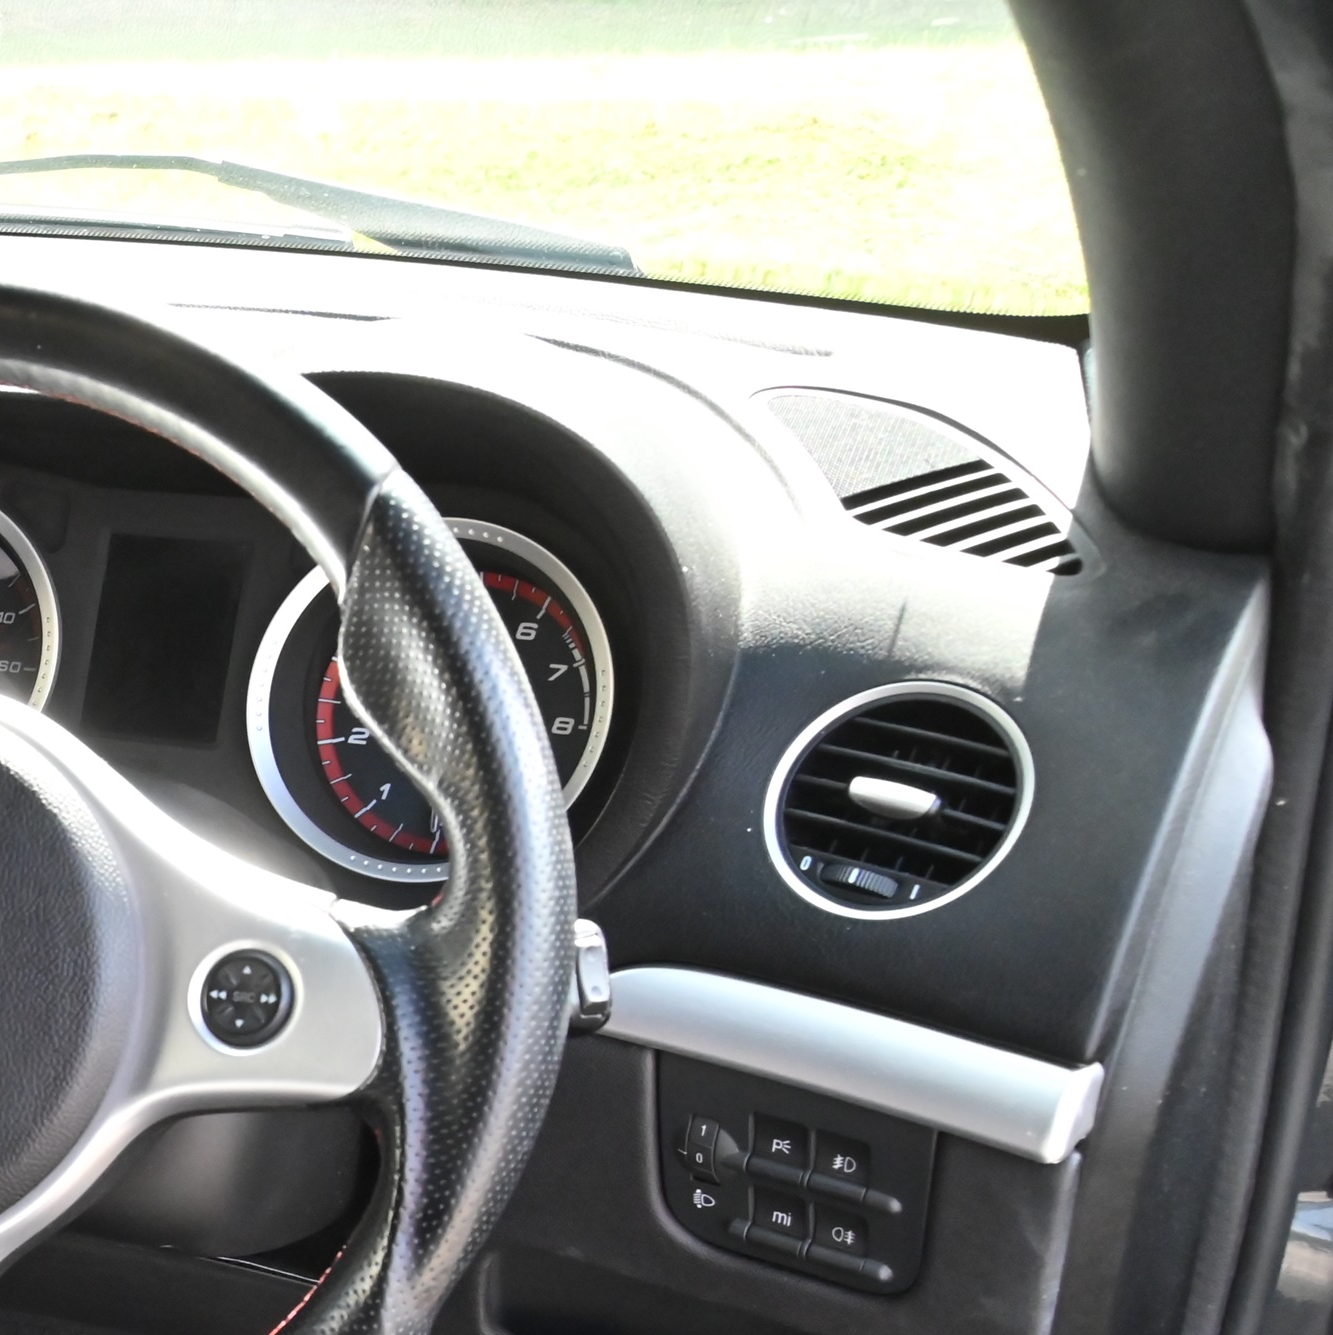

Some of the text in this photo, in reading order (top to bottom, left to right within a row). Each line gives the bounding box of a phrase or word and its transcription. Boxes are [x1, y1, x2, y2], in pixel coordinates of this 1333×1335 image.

[515, 621, 539, 641] 6
[547, 663, 568, 681] 7
[551, 717, 575, 735] 8
[347, 727, 370, 745] 2
[379, 783, 392, 799] 1
[700, 1124, 707, 1136] 1
